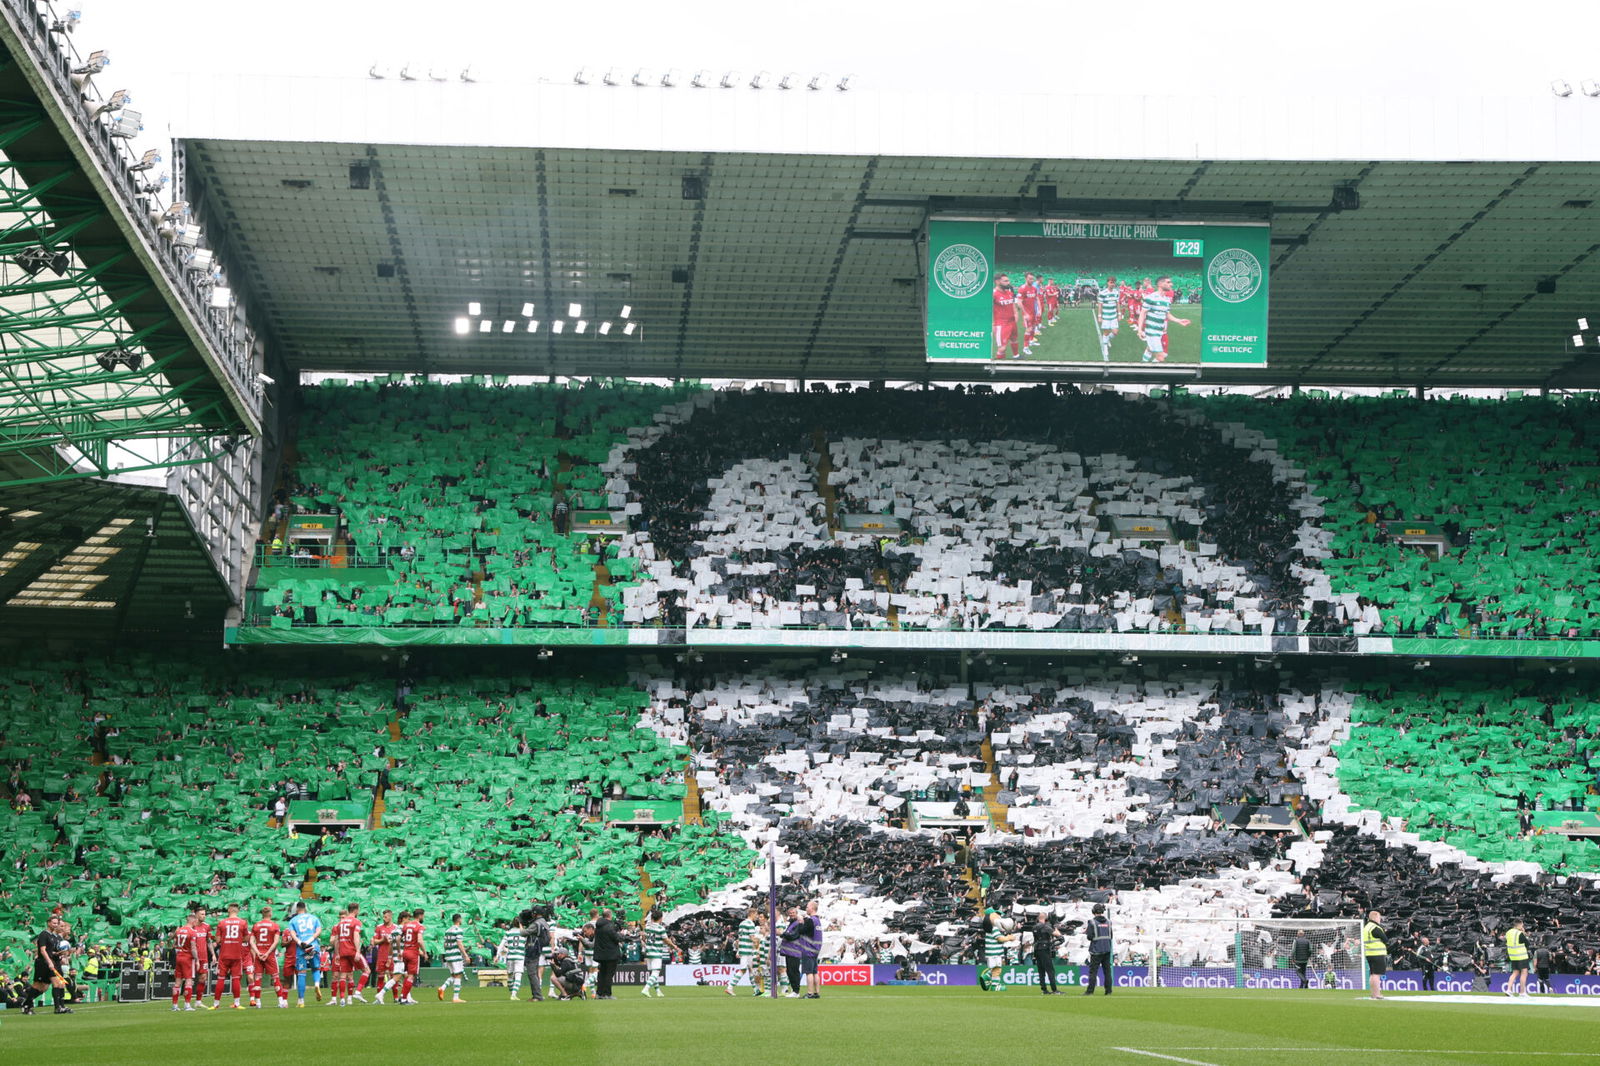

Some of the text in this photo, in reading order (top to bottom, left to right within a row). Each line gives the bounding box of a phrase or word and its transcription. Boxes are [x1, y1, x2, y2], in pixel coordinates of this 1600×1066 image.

[1042, 223, 1159, 238] WELCOME TO CELTIC PARK
[1176, 241, 1200, 255] 12:29
[934, 330, 985, 338] CELTICFC.NET
[1207, 334, 1259, 342] CELTICFC.NET
[225, 924, 240, 939] 18
[297, 919, 313, 932] 24
[339, 923, 351, 937] 15
[177, 934, 188, 947] 17
[259, 927, 268, 942] 2
[513, 935, 520, 947] 8
[612, 971, 635, 983] INKS
[819, 969, 868, 985] ports
[919, 971, 947, 985] nch
[1182, 972, 1229, 988] cinch
[1246, 972, 1293, 989] cinch
[1380, 975, 1418, 991] inch
[1436, 975, 1474, 992] cinc
[1565, 978, 1600, 995] cinc
